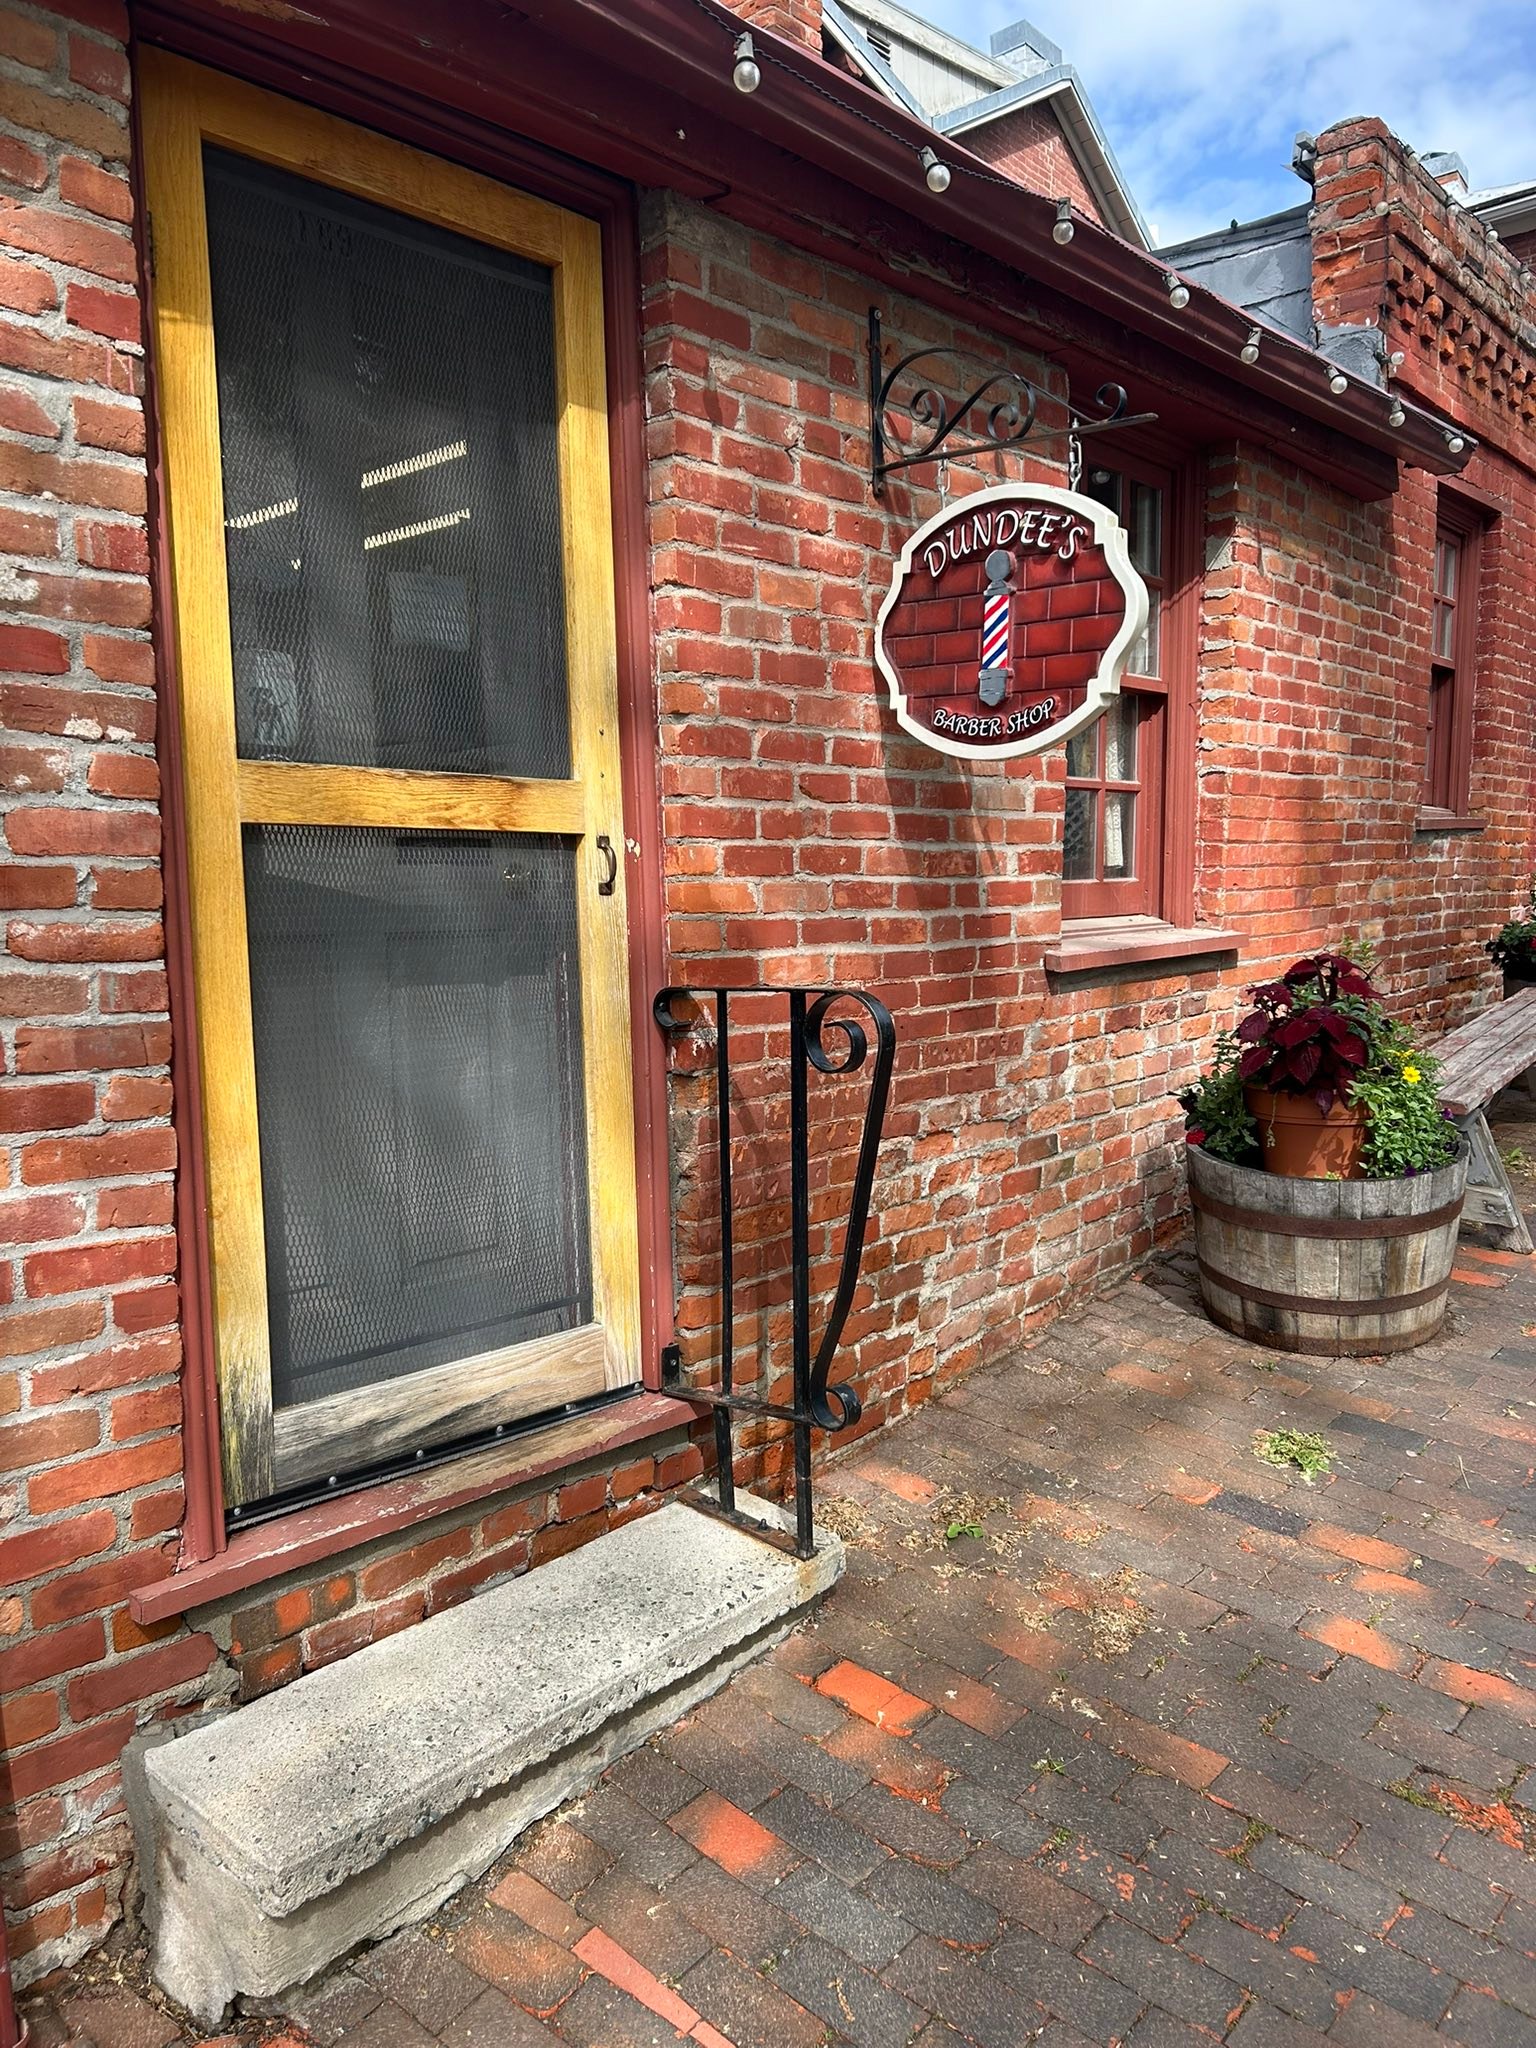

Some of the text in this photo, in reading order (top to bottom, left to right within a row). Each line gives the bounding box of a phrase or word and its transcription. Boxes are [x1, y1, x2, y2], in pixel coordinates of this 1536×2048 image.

[923, 510, 1084, 577] DUNDEE'S
[933, 697, 1055, 737] BARBER SHOP
